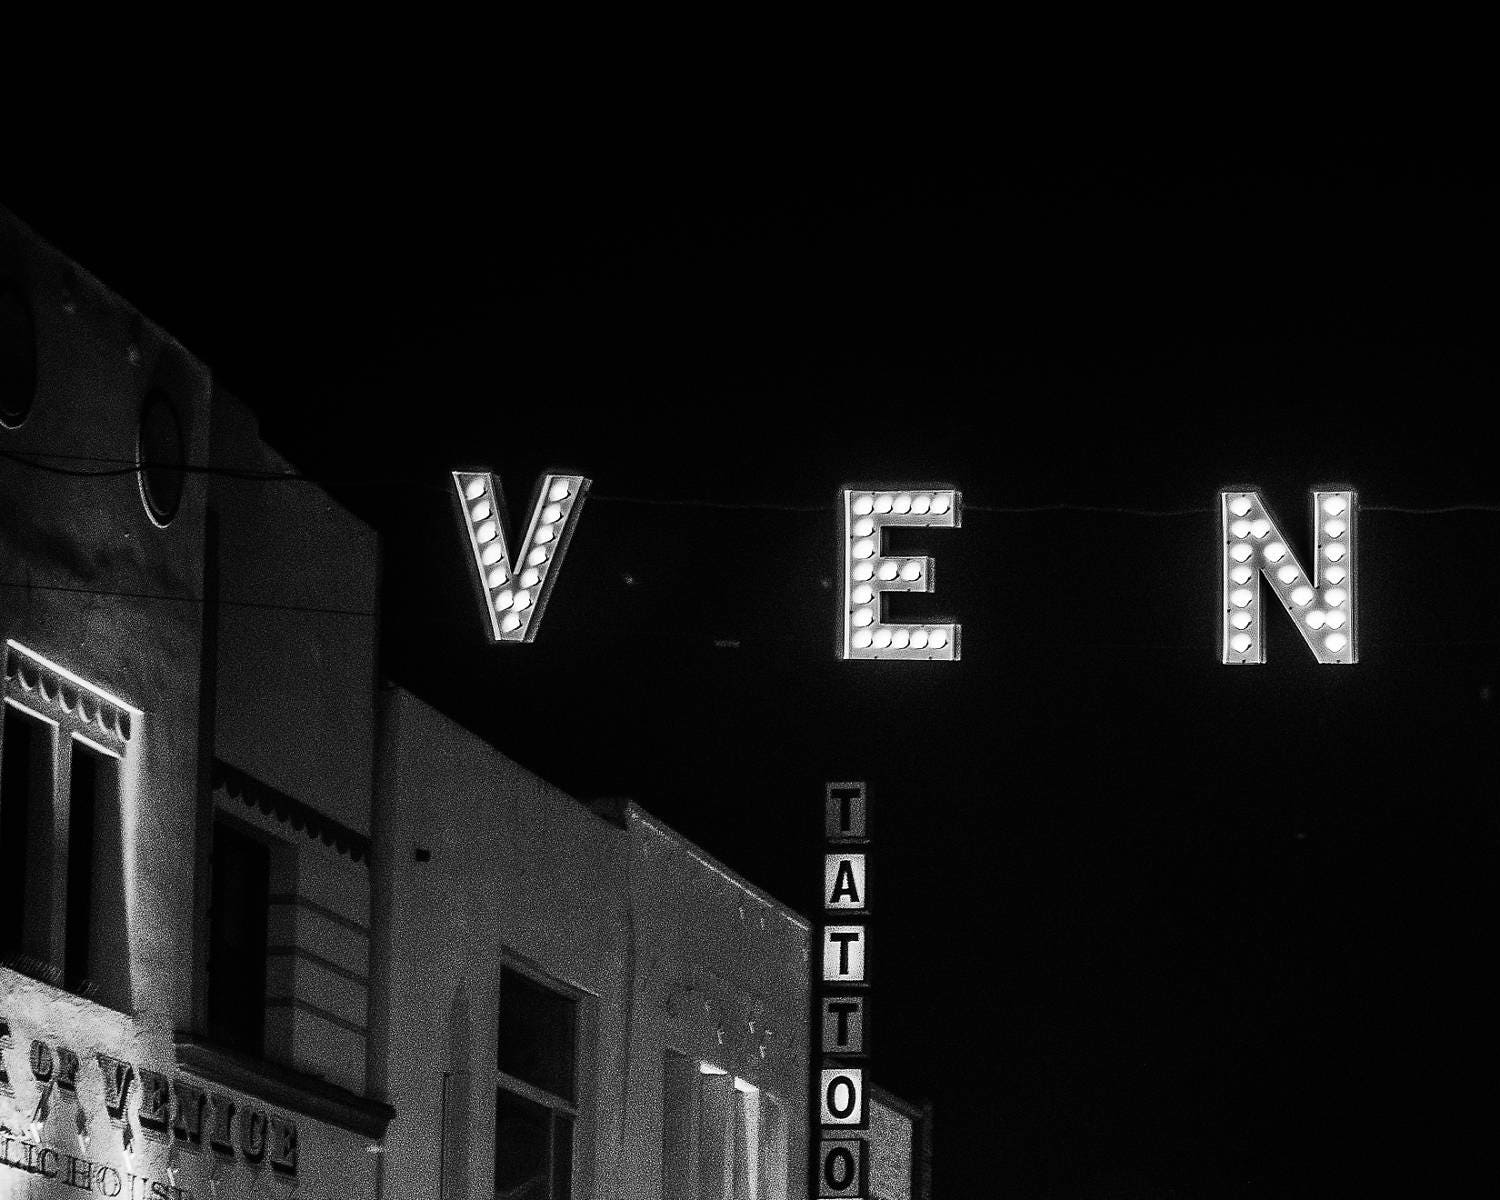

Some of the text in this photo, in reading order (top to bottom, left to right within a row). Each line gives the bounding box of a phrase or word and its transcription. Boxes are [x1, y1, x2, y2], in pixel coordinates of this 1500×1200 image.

[30, 1039, 79, 1091] OF
[96, 1052, 298, 1178] VENICE
[824, 786, 862, 1192] TATTOO
